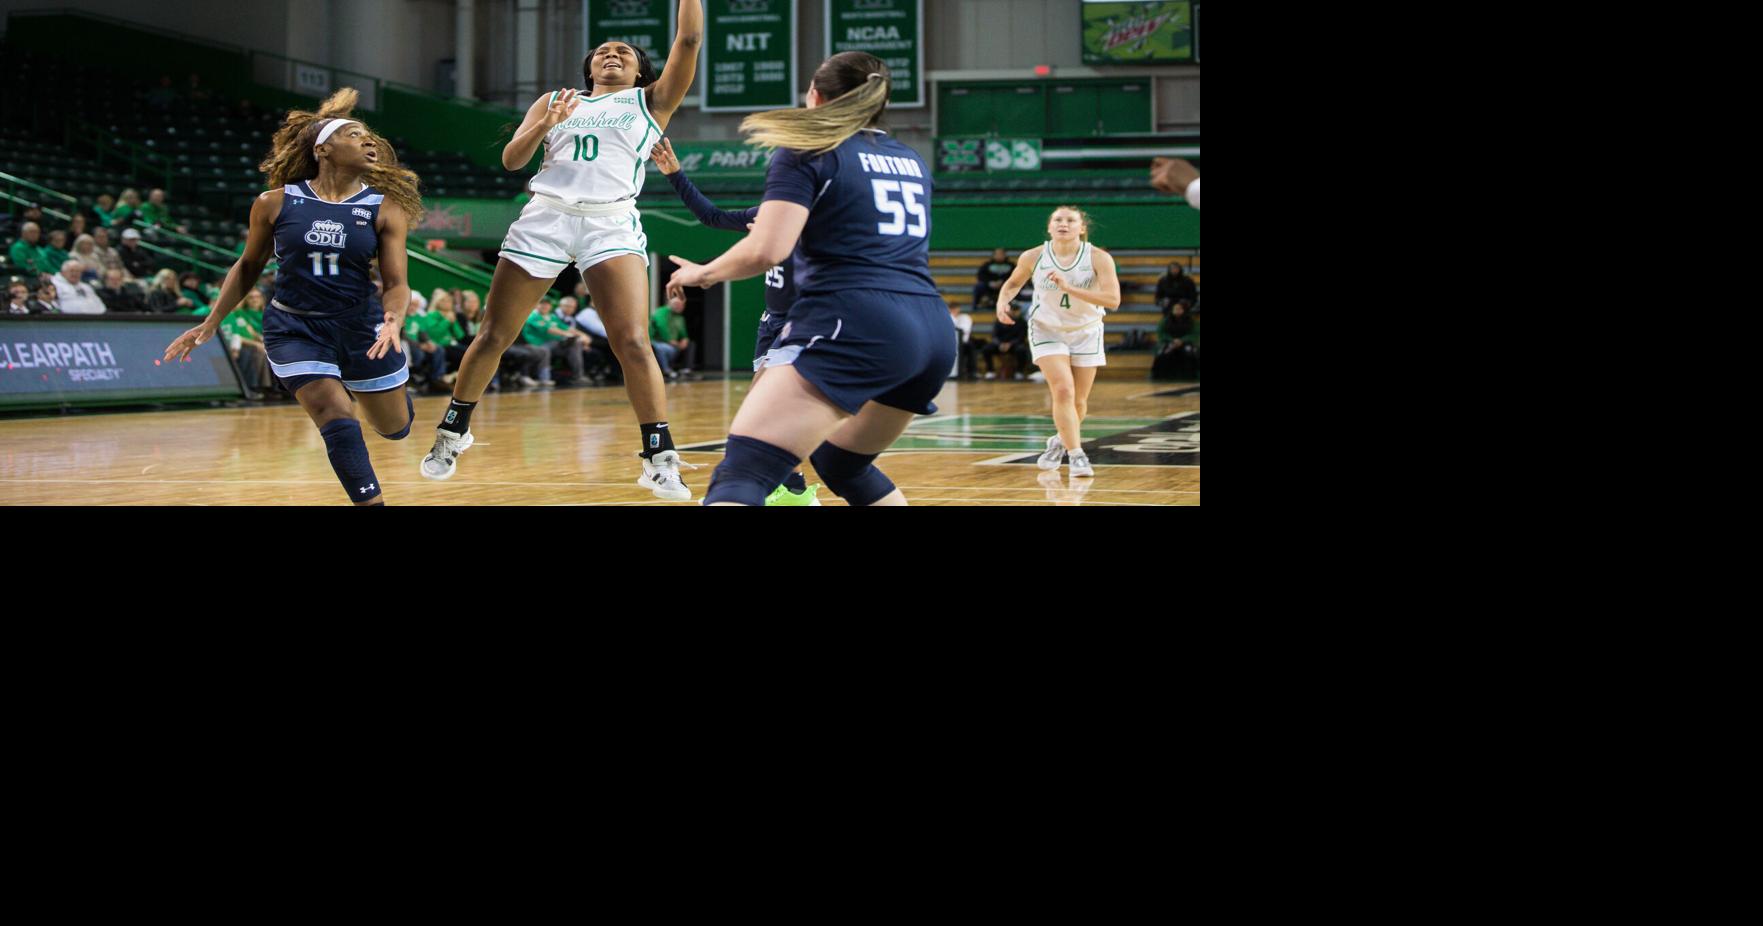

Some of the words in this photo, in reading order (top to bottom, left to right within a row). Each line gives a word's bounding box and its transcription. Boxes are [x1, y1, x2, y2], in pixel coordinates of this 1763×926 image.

[726, 32, 772, 51] NIT
[847, 25, 900, 40] NCAA
[573, 134, 599, 161] 10
[871, 178, 926, 238] 55
[305, 231, 347, 248] ODU
[307, 252, 340, 276] 11
[765, 266, 784, 288] 25
[1060, 293, 1071, 309] 4
[68, 368, 120, 381] SPECIALTY
